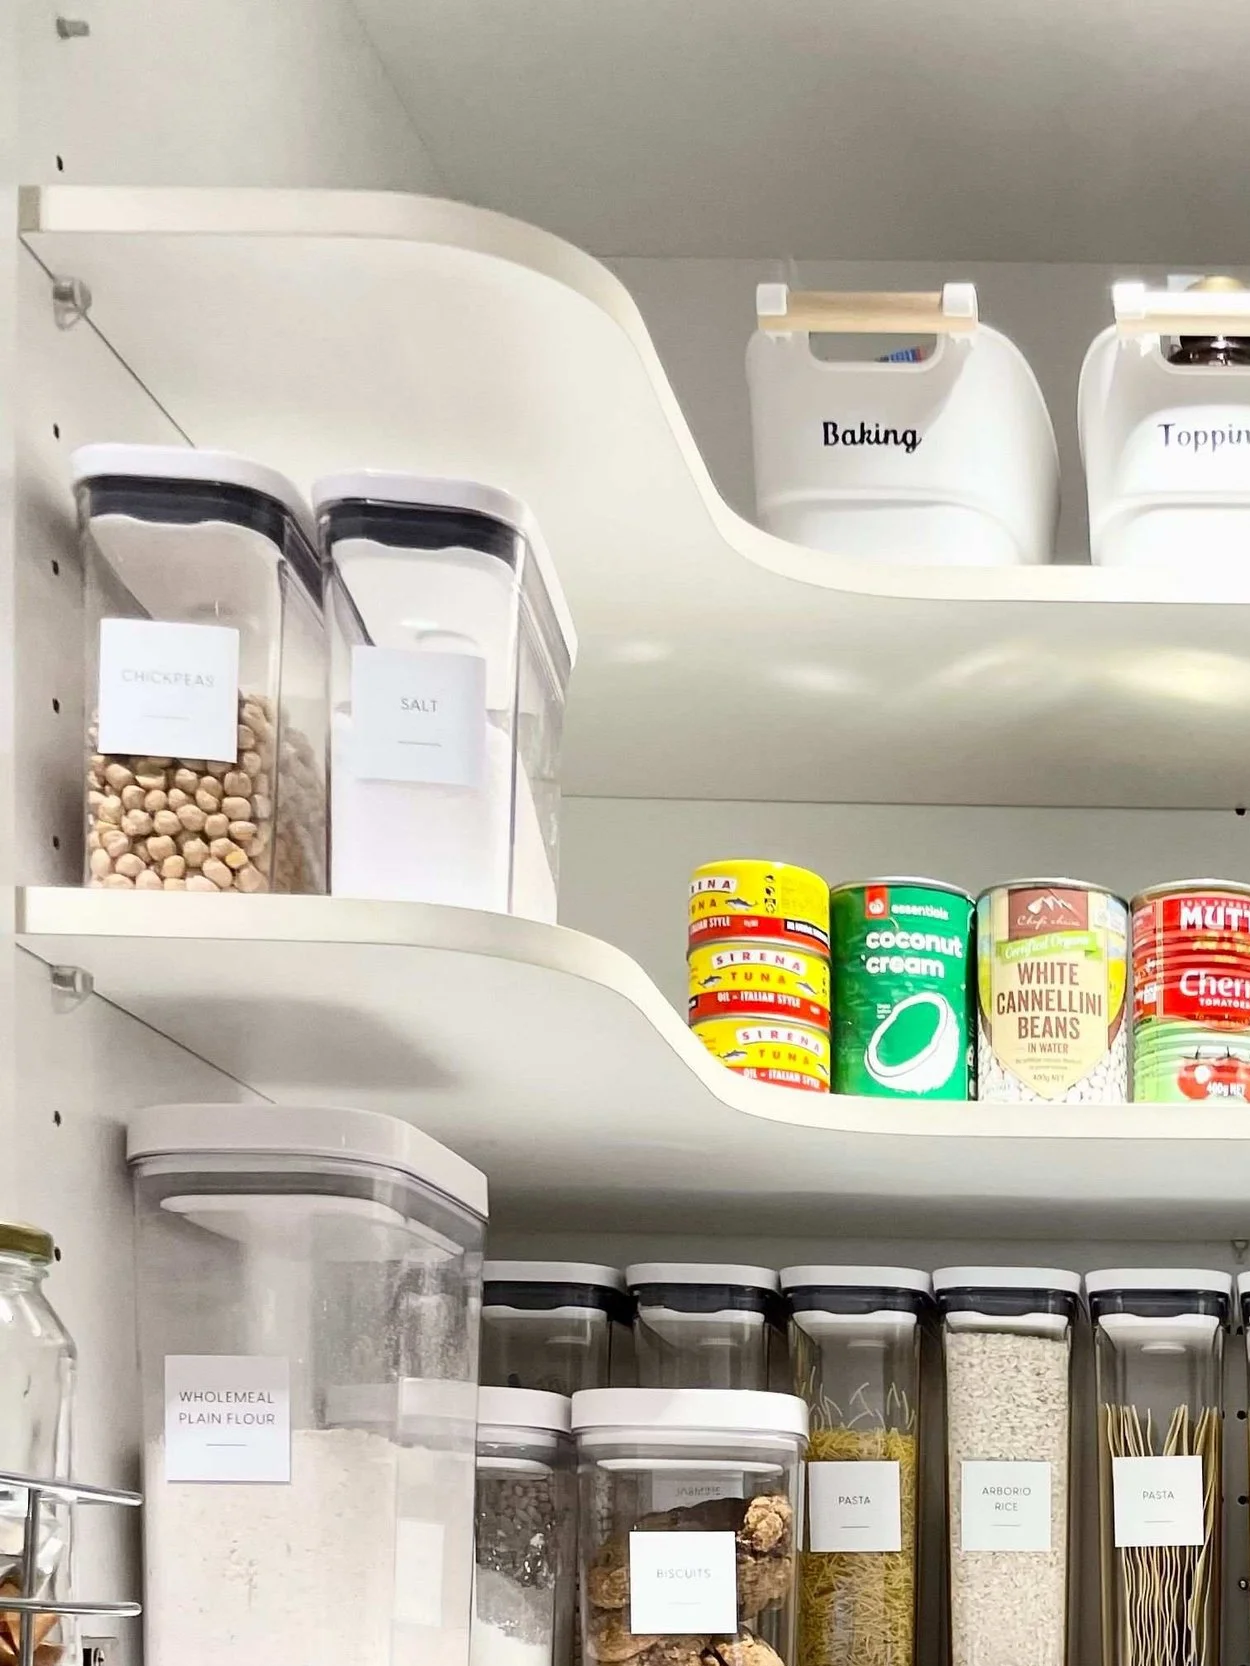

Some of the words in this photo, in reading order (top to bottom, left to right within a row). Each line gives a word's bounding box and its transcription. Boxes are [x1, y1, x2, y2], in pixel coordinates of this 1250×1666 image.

[823, 421, 922, 453] Baking
[120, 668, 215, 688] CHICKPEAS
[400, 696, 438, 713] SALT
[891, 902, 950, 920] essentials
[865, 931, 964, 958] coconut
[716, 951, 801, 970] SIRENA
[865, 955, 945, 979] cream
[730, 971, 786, 984] TUNA
[1017, 961, 1079, 985] WHITE
[718, 991, 730, 1002] OIL
[741, 989, 774, 1003] ITALIAN
[777, 993, 800, 1009] STYLE
[996, 989, 1102, 1017] CANNELLINI
[1017, 1016, 1081, 1040] BEANS
[742, 1029, 821, 1053] SIRENA
[1027, 1043, 1037, 1053] IN
[1039, 1043, 1069, 1054] WATER
[758, 1049, 810, 1064] TUNA
[179, 1391, 276, 1404] WHOLEMEAL
[178, 1412, 222, 1425] PLAIN
[227, 1412, 275, 1425] FLOUR
[981, 1487, 1031, 1496] ARBORIO
[1142, 1490, 1175, 1500] PASTA
[838, 1495, 871, 1506] PASTA
[994, 1502, 1018, 1512] RICE
[656, 1568, 711, 1579] BISCUITS
